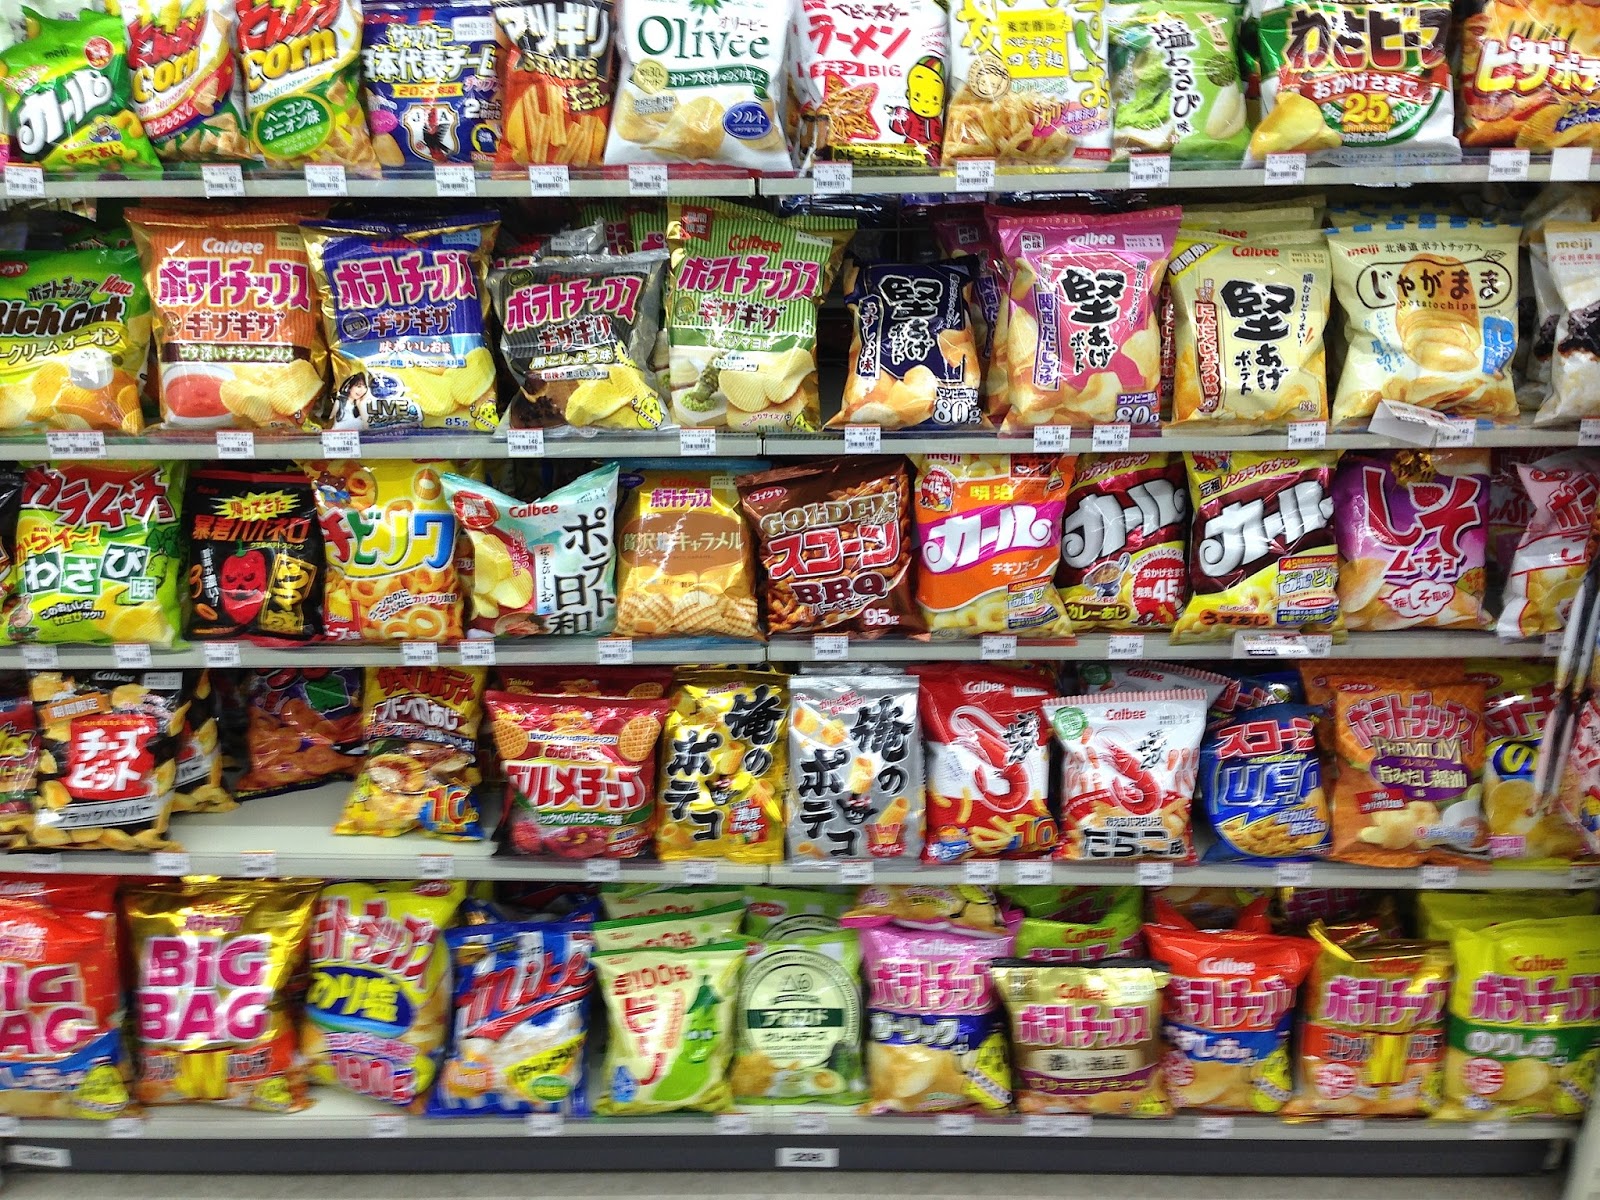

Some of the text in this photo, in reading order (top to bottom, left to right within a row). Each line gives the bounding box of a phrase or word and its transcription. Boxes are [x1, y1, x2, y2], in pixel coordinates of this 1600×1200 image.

[808, 14, 911, 58] ラーメン
[812, 61, 860, 77] チキン
[868, 64, 902, 78] BIG
[1312, 75, 1420, 99] おかげさまで
[17, 69, 113, 154] カール
[732, 111, 766, 125] ソルト
[1344, 93, 1390, 124] 25
[263, 111, 320, 141] オニオン味
[202, 237, 265, 255] Calbee
[728, 235, 783, 253] Calbee
[1168, 242, 1218, 276] 期間限定
[1231, 245, 1280, 258] Calbee
[1347, 241, 1483, 257] meiji 北海道 ポテトチップス
[1555, 238, 1593, 251] meiji
[28, 277, 100, 301] ポテトチップス
[99, 274, 134, 296] New
[159, 260, 312, 312] ポテトチップス
[337, 250, 476, 310] ポテトチップス
[677, 253, 822, 300] ポテトチップス
[1370, 267, 1501, 300] じゃがまま
[504, 276, 643, 333] ポテトチップス
[879, 273, 945, 322] 堅
[1060, 264, 1127, 325] 堅
[1219, 279, 1298, 342] 堅
[185, 311, 287, 339] ギザギザ
[372, 304, 457, 337] ギザギザ
[699, 298, 787, 330] ギザギザ
[908, 319, 934, 363] あげ
[1087, 325, 1119, 369] あげ
[530, 351, 614, 369] 黒こしょう味
[1233, 350, 1252, 396] ポテト
[1255, 342, 1289, 391] あげ
[366, 399, 409, 416] LIVE
[445, 417, 469, 428] 85g
[932, 398, 983, 426] 80g
[1222, 457, 1300, 488] ノンフライスナック
[21, 464, 176, 531] カラムーチョ
[651, 487, 713, 508] ポテトチップス
[751, 487, 784, 502] コイケヤ
[969, 484, 1014, 500] 明治
[508, 503, 559, 519] Calbee
[759, 492, 897, 538] GOLDEN
[1061, 478, 1187, 570] カール
[1362, 466, 1482, 559] しそ
[921, 504, 1053, 574] カール
[1199, 479, 1335, 578] カール
[563, 506, 616, 618] ポテト
[768, 522, 900, 579] スコーン
[990, 555, 1044, 577] チキンスープ
[1387, 546, 1459, 574] ムーチョ
[25, 546, 148, 594] わさび
[792, 571, 888, 605] BBQ
[863, 608, 900, 626] 95g
[1067, 603, 1129, 621] カレーあじ
[1202, 612, 1270, 626] うすあじ
[963, 680, 1005, 693] Calbee
[51, 699, 100, 718] 期間限定
[1104, 708, 1147, 721] Calbee
[1346, 691, 1481, 752] ポテトチップス
[77, 724, 151, 759] チーズ
[1217, 717, 1317, 760] スコーン
[1373, 738, 1462, 764] PREMIUM
[70, 758, 143, 792] ビット
[660, 730, 725, 842] ポテコ
[798, 747, 862, 857] ポテコ
[147, 936, 272, 988] BIG
[1198, 957, 1257, 975] Calbee
[0, 963, 80, 1011] IG
[0, 1006, 98, 1055] AG
[137, 991, 273, 1042] BAG
